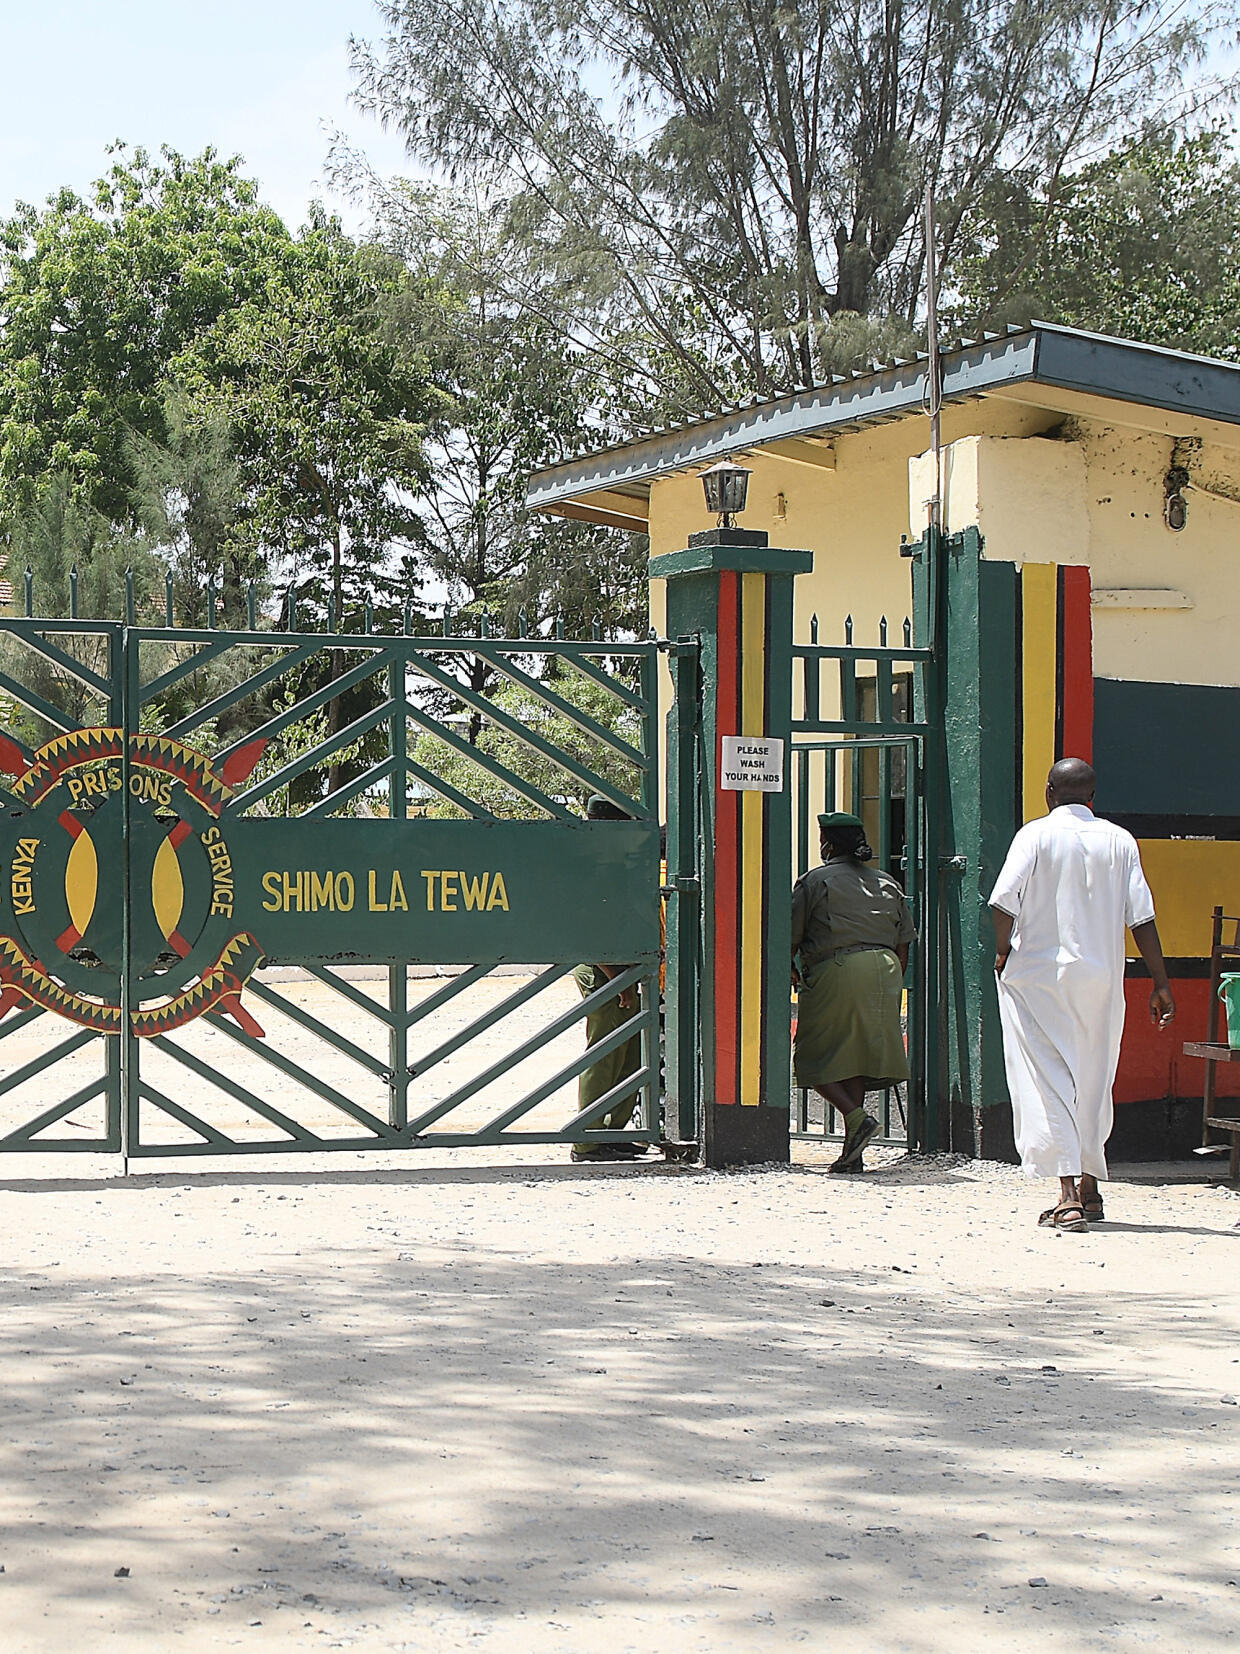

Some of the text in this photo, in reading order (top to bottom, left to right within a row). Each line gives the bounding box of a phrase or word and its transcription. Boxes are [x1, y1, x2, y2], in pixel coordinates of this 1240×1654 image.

[737, 746, 769, 755] PLEASE
[740, 760, 765, 768] WASH
[725, 772, 780, 783] YOUR HANDS
[11, 768, 234, 919] KENYA PRISONS SERVICE
[261, 870, 510, 912] SHIMO LA TEWA
